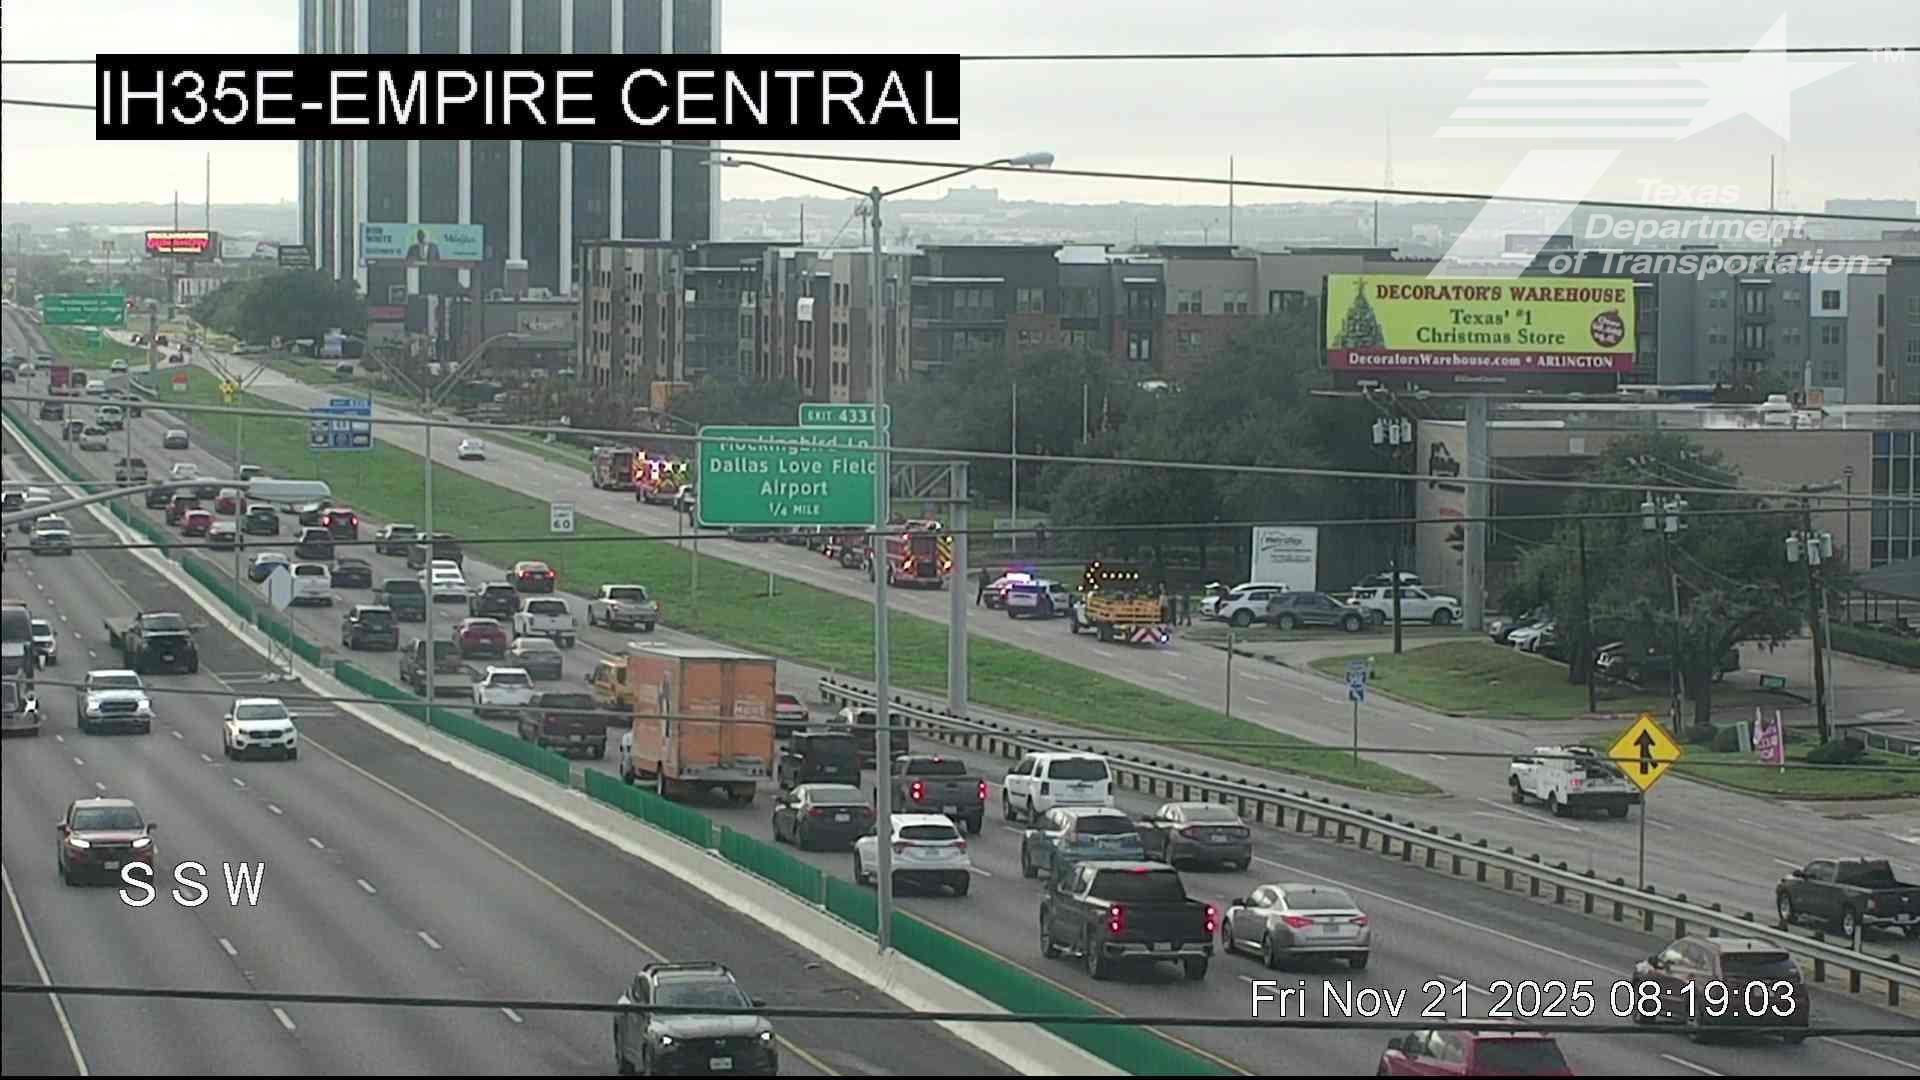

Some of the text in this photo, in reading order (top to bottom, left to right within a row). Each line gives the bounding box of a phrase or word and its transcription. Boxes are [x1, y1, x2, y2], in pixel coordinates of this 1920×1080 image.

[1376, 284, 1627, 304] DECORATOR'S WAREHOUSE
[1450, 309, 1510, 326] Texas'
[1416, 327, 1566, 346] Christmas Store
[1349, 352, 1613, 368] DecoratorsWarehouse.com ARLINGTON
[807, 410, 833, 422] EXIT
[710, 458, 769, 473] Dallas
[779, 458, 822, 474] Love
[760, 479, 828, 498] Airport
[793, 504, 820, 515] MILE
